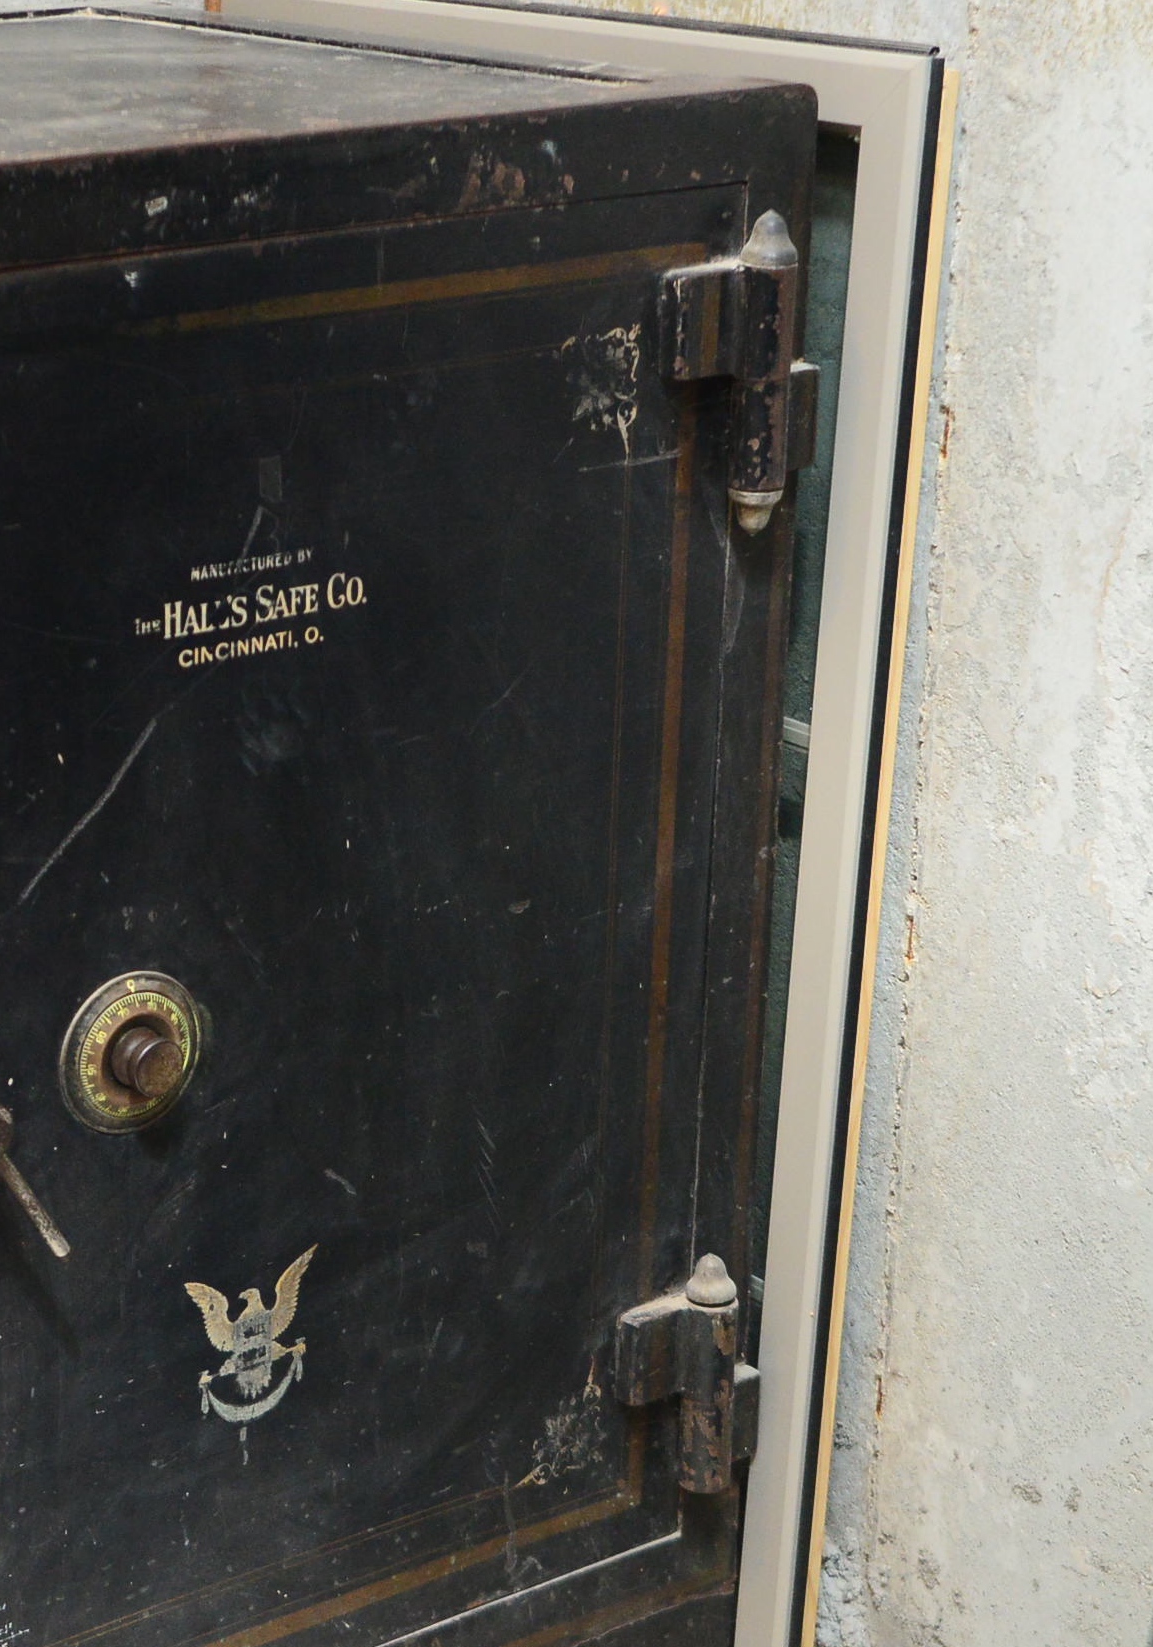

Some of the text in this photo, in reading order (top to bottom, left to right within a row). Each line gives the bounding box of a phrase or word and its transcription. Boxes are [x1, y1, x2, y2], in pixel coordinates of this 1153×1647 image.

[190, 547, 315, 582] MANUFACTURED BY
[255, 583, 319, 624] SAFE
[327, 572, 368, 610] CO.
[177, 626, 325, 668] CINCINNATI, O.
